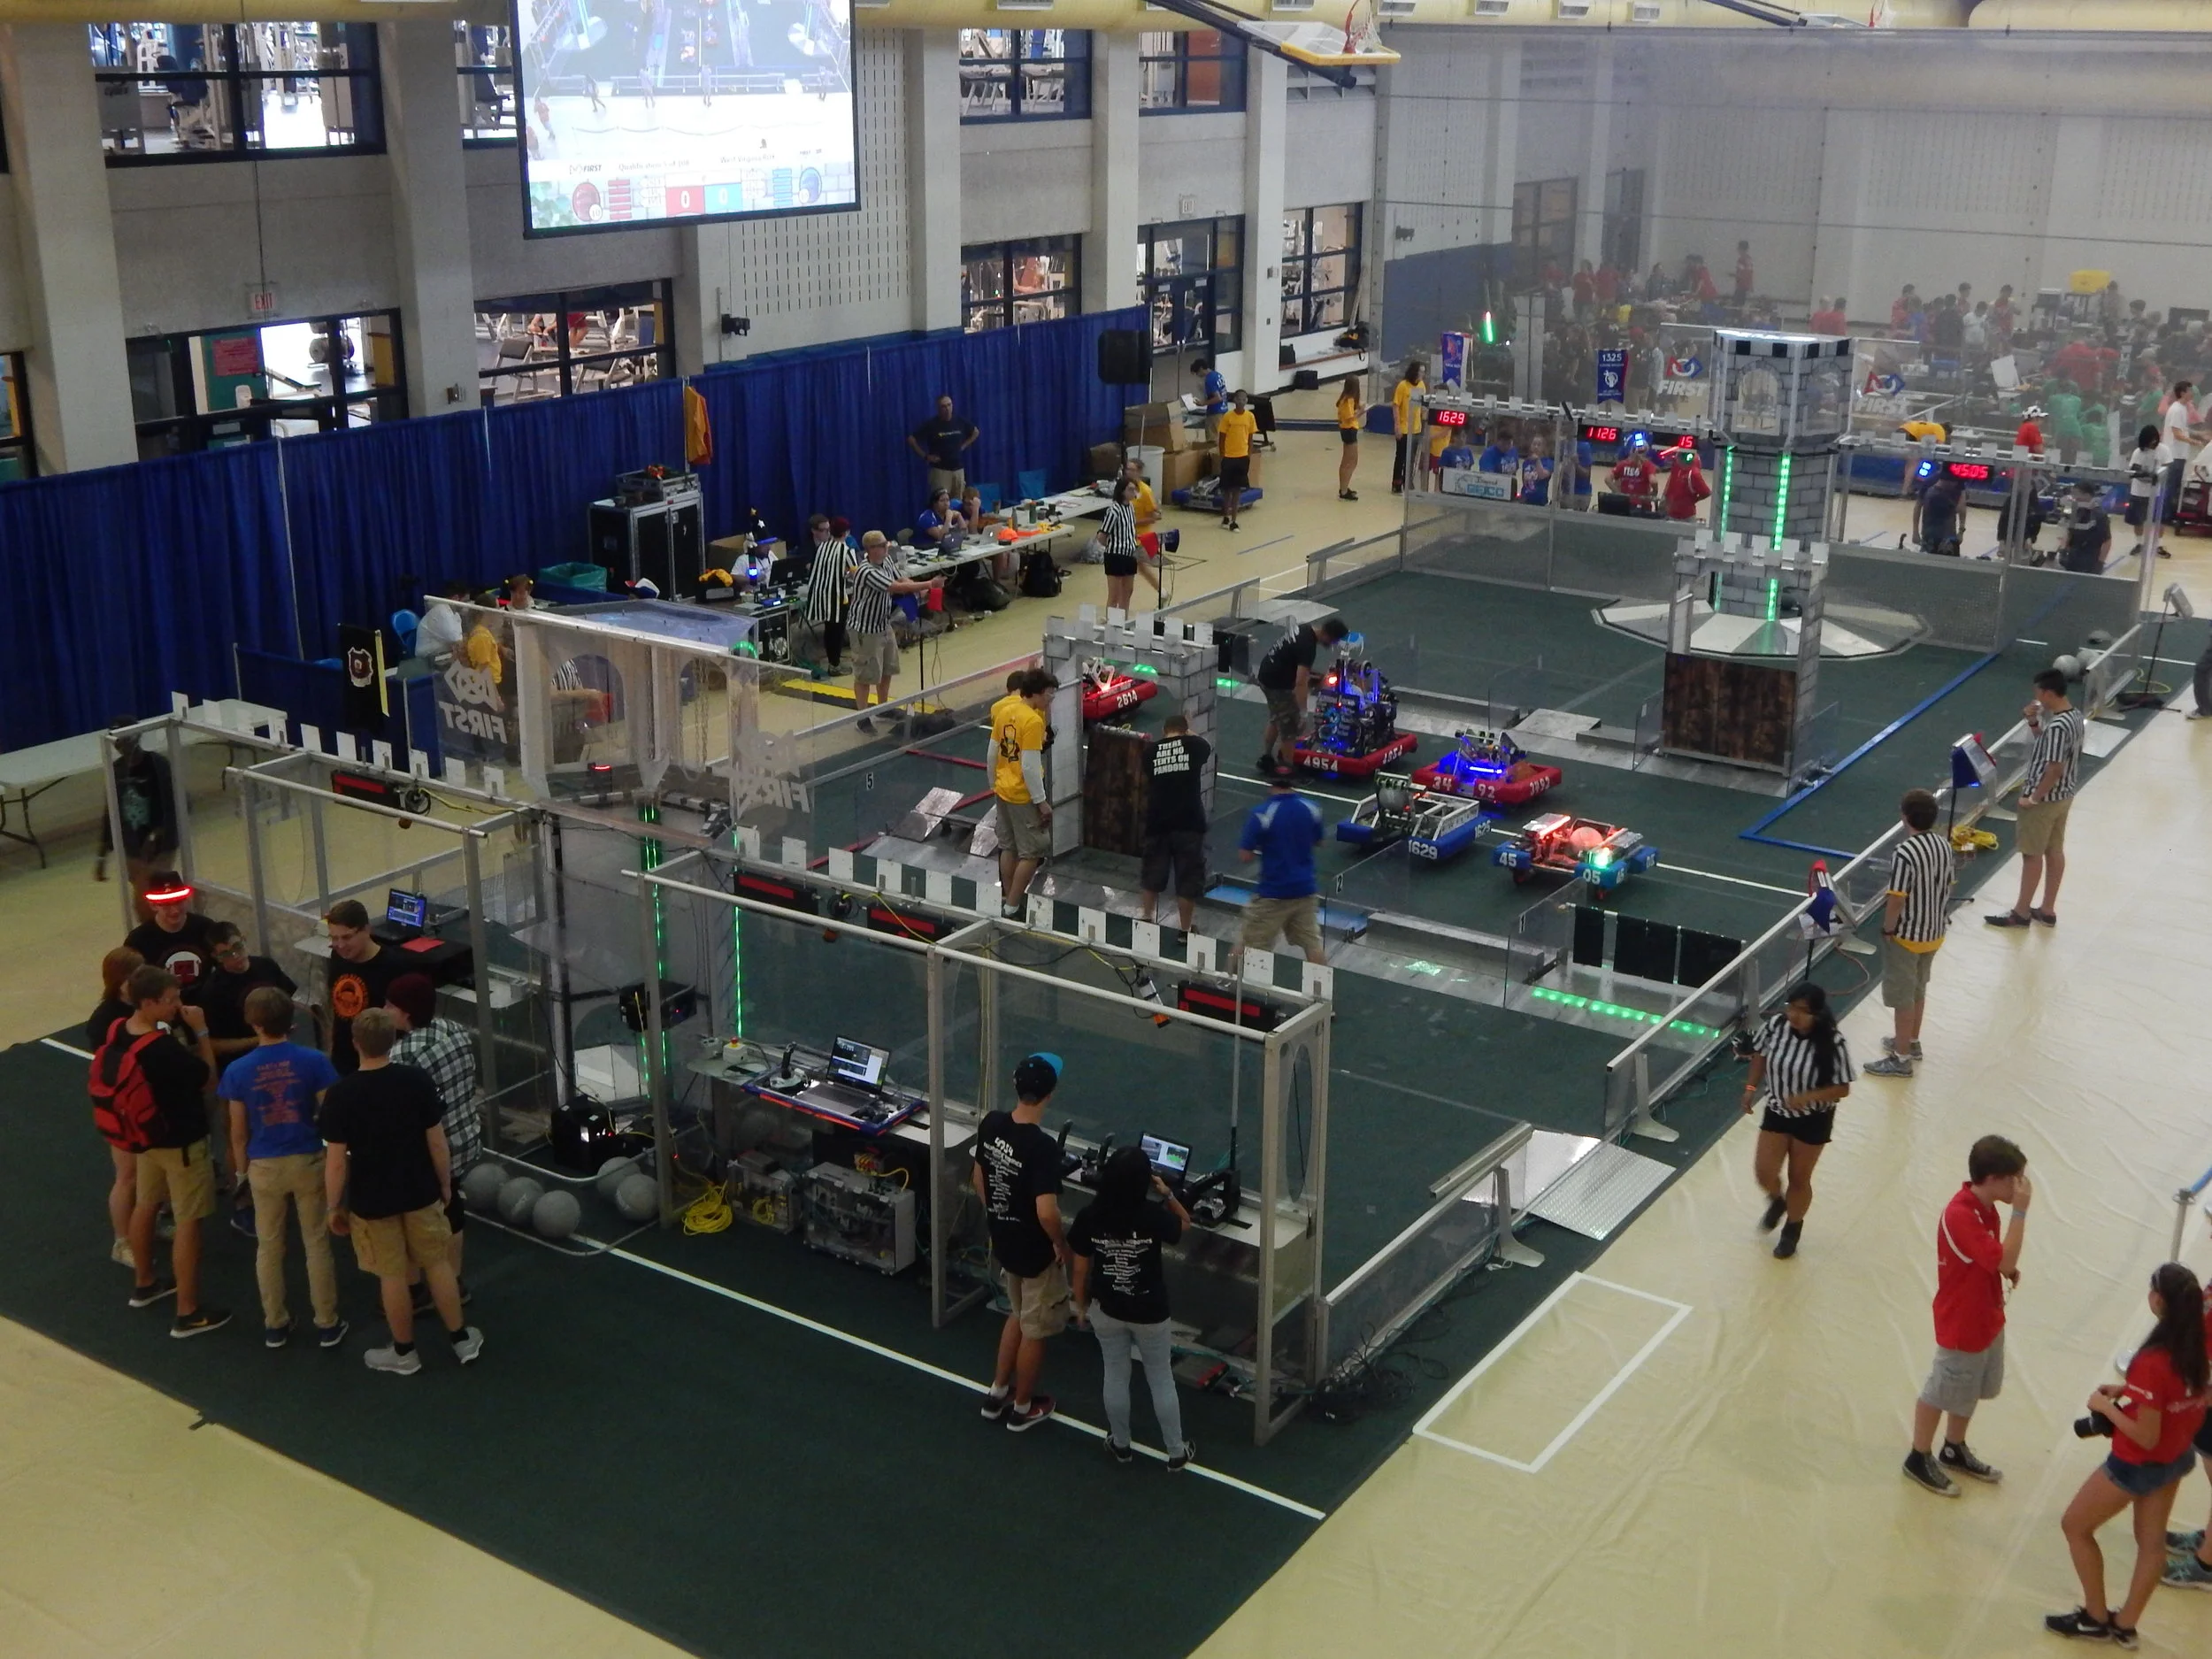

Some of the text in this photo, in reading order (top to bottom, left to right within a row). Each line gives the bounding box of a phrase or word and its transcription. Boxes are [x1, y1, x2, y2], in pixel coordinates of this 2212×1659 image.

[583, 164, 602, 173] FIRST
[680, 190, 690, 209] 0
[254, 292, 273, 310] EXIT
[1602, 353, 1622, 362] 1325
[1656, 380, 1709, 396] FIRST
[1855, 398, 1909, 413] FIRST
[1439, 411, 1465, 425] 1629
[1588, 426, 1617, 441] 1126
[1949, 462, 1989, 479] 4505
[1117, 689, 1138, 708] 2614
[1156, 746, 1185, 758] ARE NO
[1157, 739, 1182, 750] THERE
[1153, 754, 1189, 767] TENTS ON
[1303, 756, 1338, 772] 4954
[1154, 763, 1190, 776] PANDORA
[867, 772, 873, 789] 5
[1432, 776, 1495, 798] 34 92
[1529, 776, 1550, 796] 3492
[1409, 839, 1438, 860] 1629
[1499, 852, 1601, 885] 45 05
[1337, 873, 1343, 893] 2
